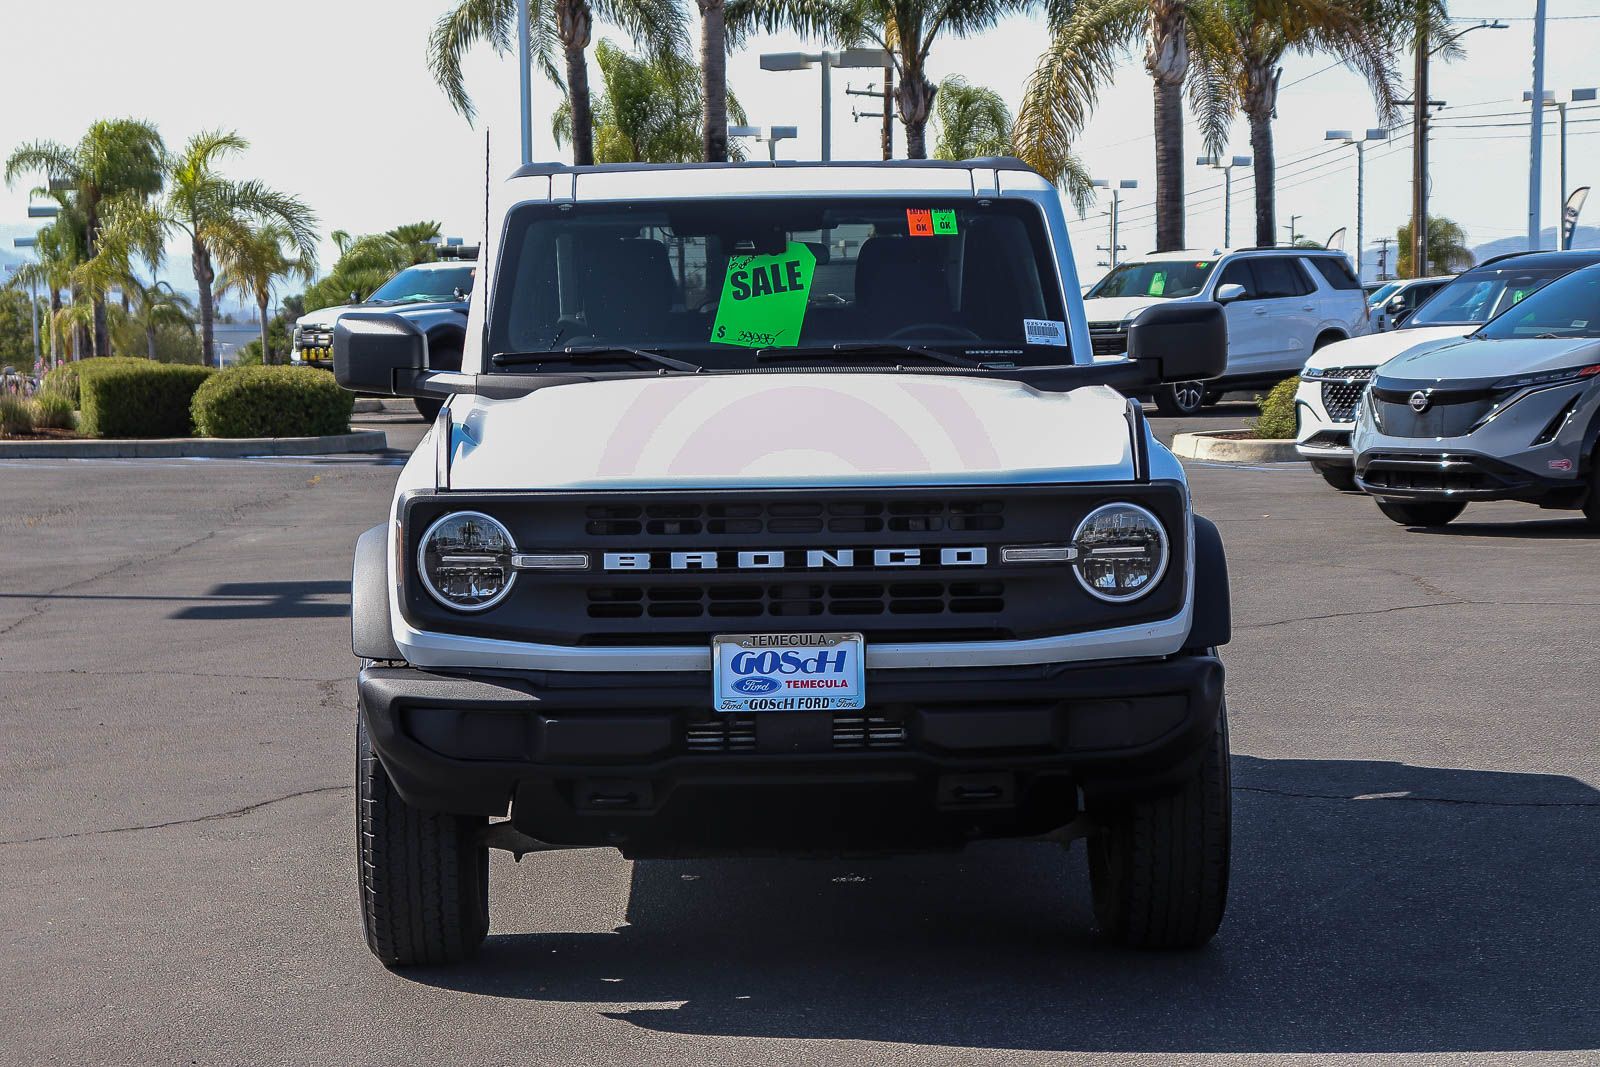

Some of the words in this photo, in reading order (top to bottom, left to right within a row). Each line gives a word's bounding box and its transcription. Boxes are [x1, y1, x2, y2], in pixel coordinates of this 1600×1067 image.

[916, 223, 928, 232] OK
[940, 221, 952, 230] OK
[730, 260, 805, 301] SALE
[716, 325, 726, 339] $
[603, 547, 988, 570] BRONCO
[750, 634, 827, 646] TEMECULA
[742, 679, 770, 692] Ford
[785, 679, 849, 689] TEMECULA
[720, 699, 743, 710] Ford
[797, 697, 830, 709] FORD
[836, 697, 859, 708] Ford
